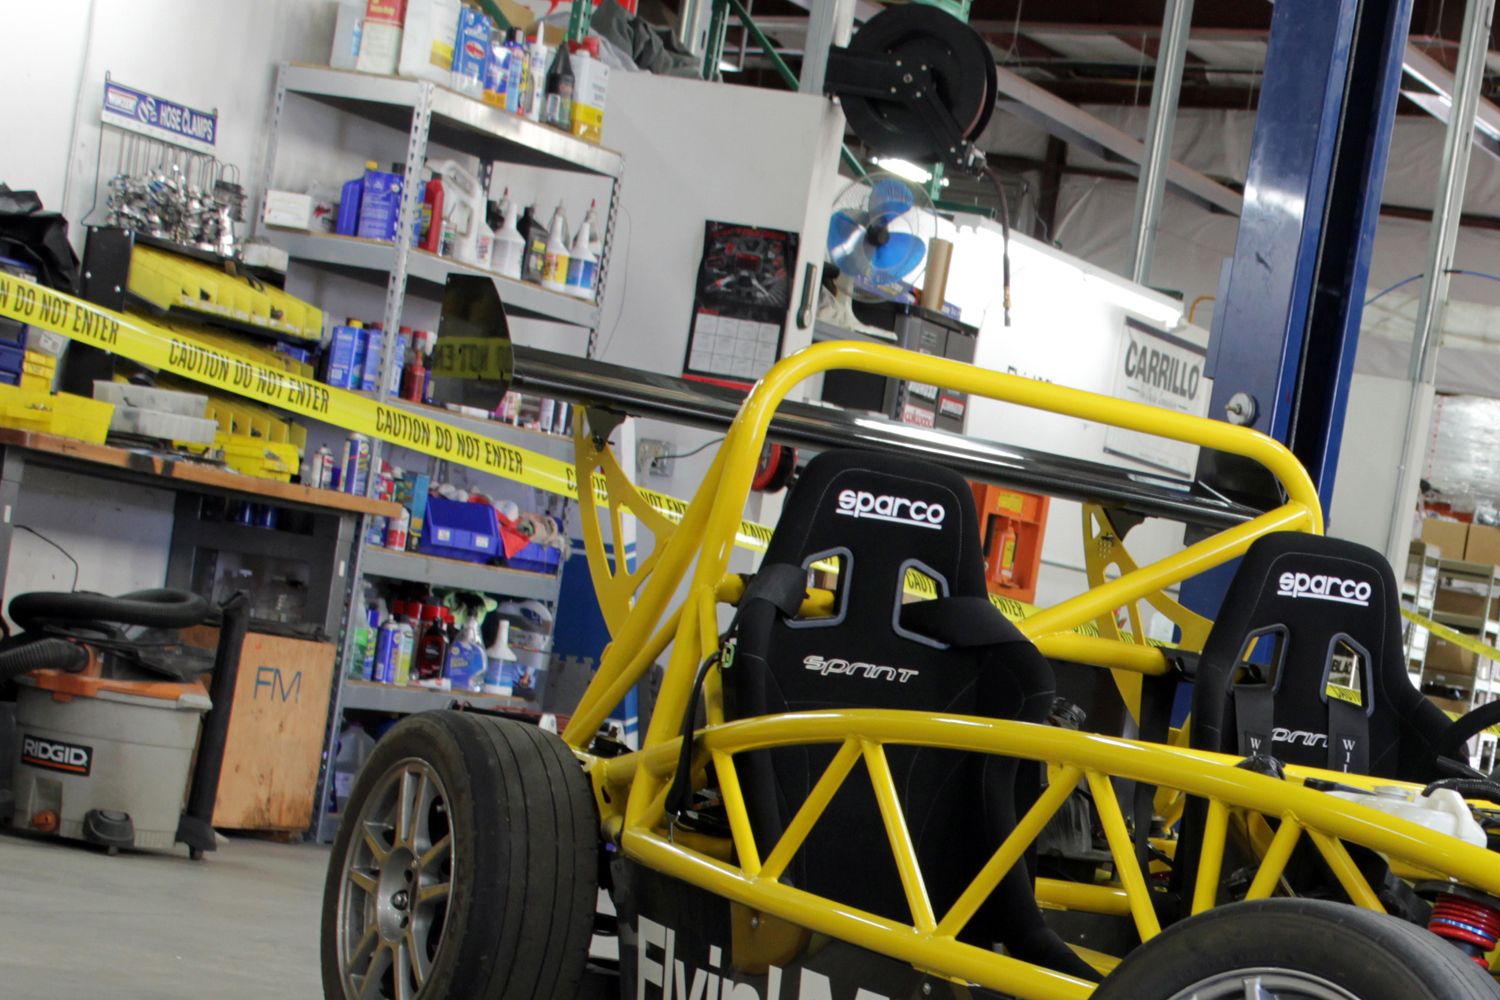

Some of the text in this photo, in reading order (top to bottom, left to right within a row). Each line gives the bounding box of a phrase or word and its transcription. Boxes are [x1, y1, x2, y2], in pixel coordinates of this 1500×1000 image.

[160, 103, 213, 141] HOSE CLAMPS
[14, 285, 35, 316] DO
[40, 294, 70, 328] NOT
[72, 304, 120, 345] ENTER
[168, 338, 330, 414] CAUTION DO NOT ENTER
[1125, 340, 1199, 400] CARRILLO
[376, 406, 523, 475] CAUTION DO NOT ENTER
[838, 489, 945, 523] sparco
[1279, 572, 1372, 601] sparco
[253, 666, 303, 704] FM
[23, 738, 88, 766] RIDGID
